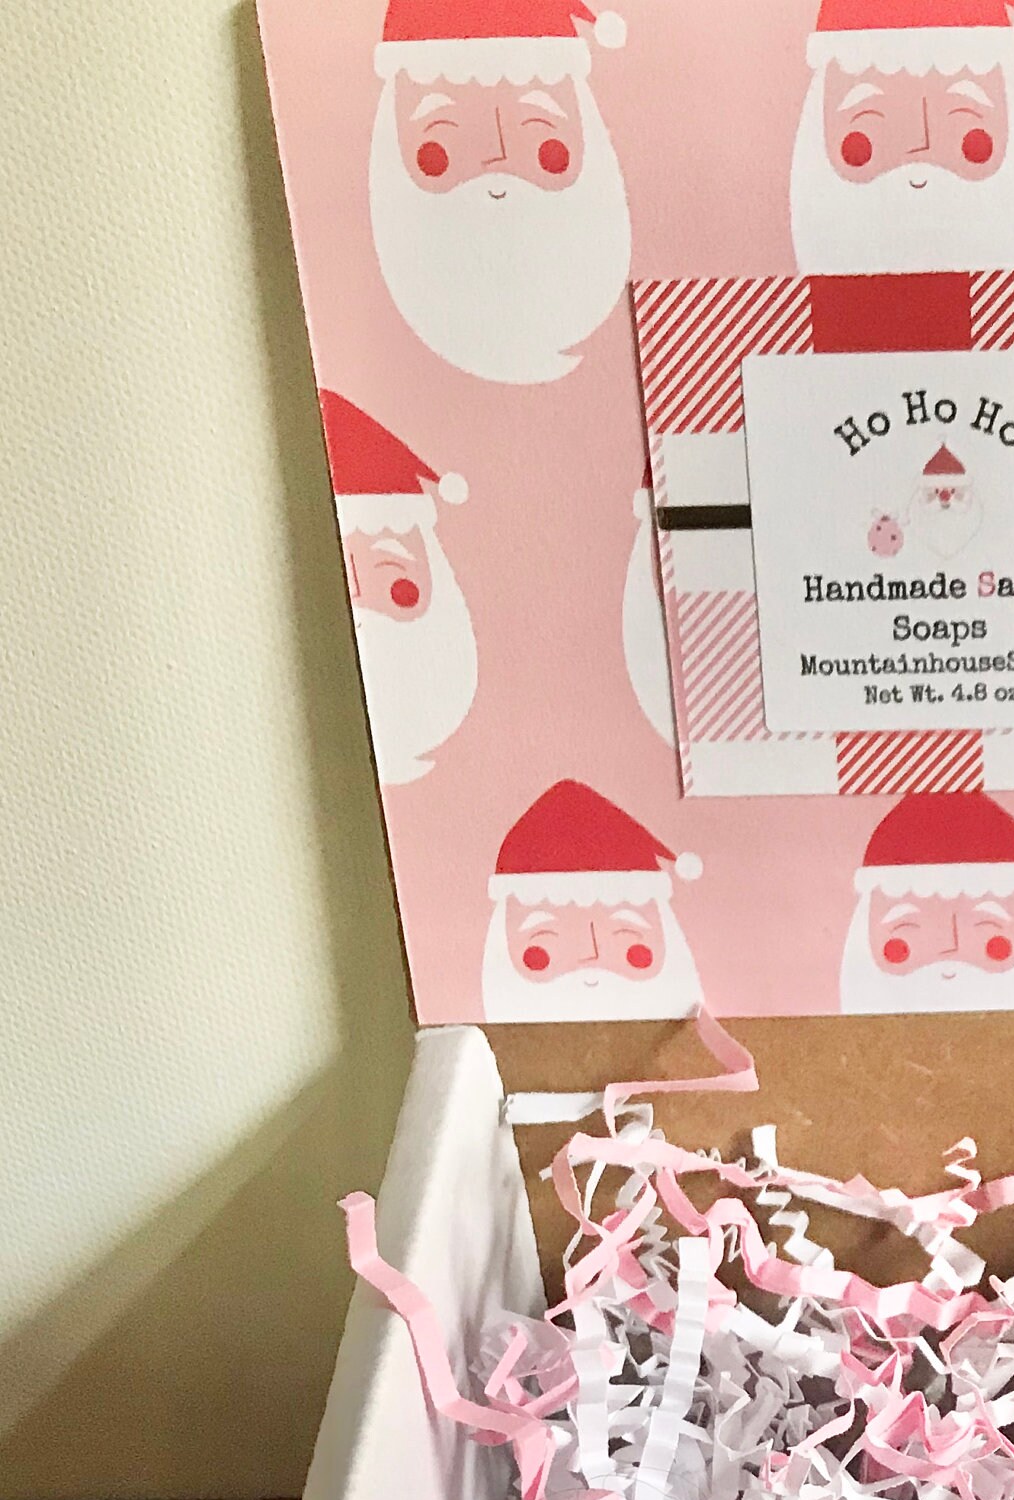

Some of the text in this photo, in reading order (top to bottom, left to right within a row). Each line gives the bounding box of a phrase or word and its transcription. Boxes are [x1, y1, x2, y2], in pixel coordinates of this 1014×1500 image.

[834, 411, 891, 456] Ho
[902, 390, 958, 425] Ho
[803, 572, 967, 603] Handmade
[893, 614, 988, 647] Soaps
[864, 685, 903, 705] Net
[909, 684, 945, 703] Wt.
[951, 685, 987, 703] 4.8
